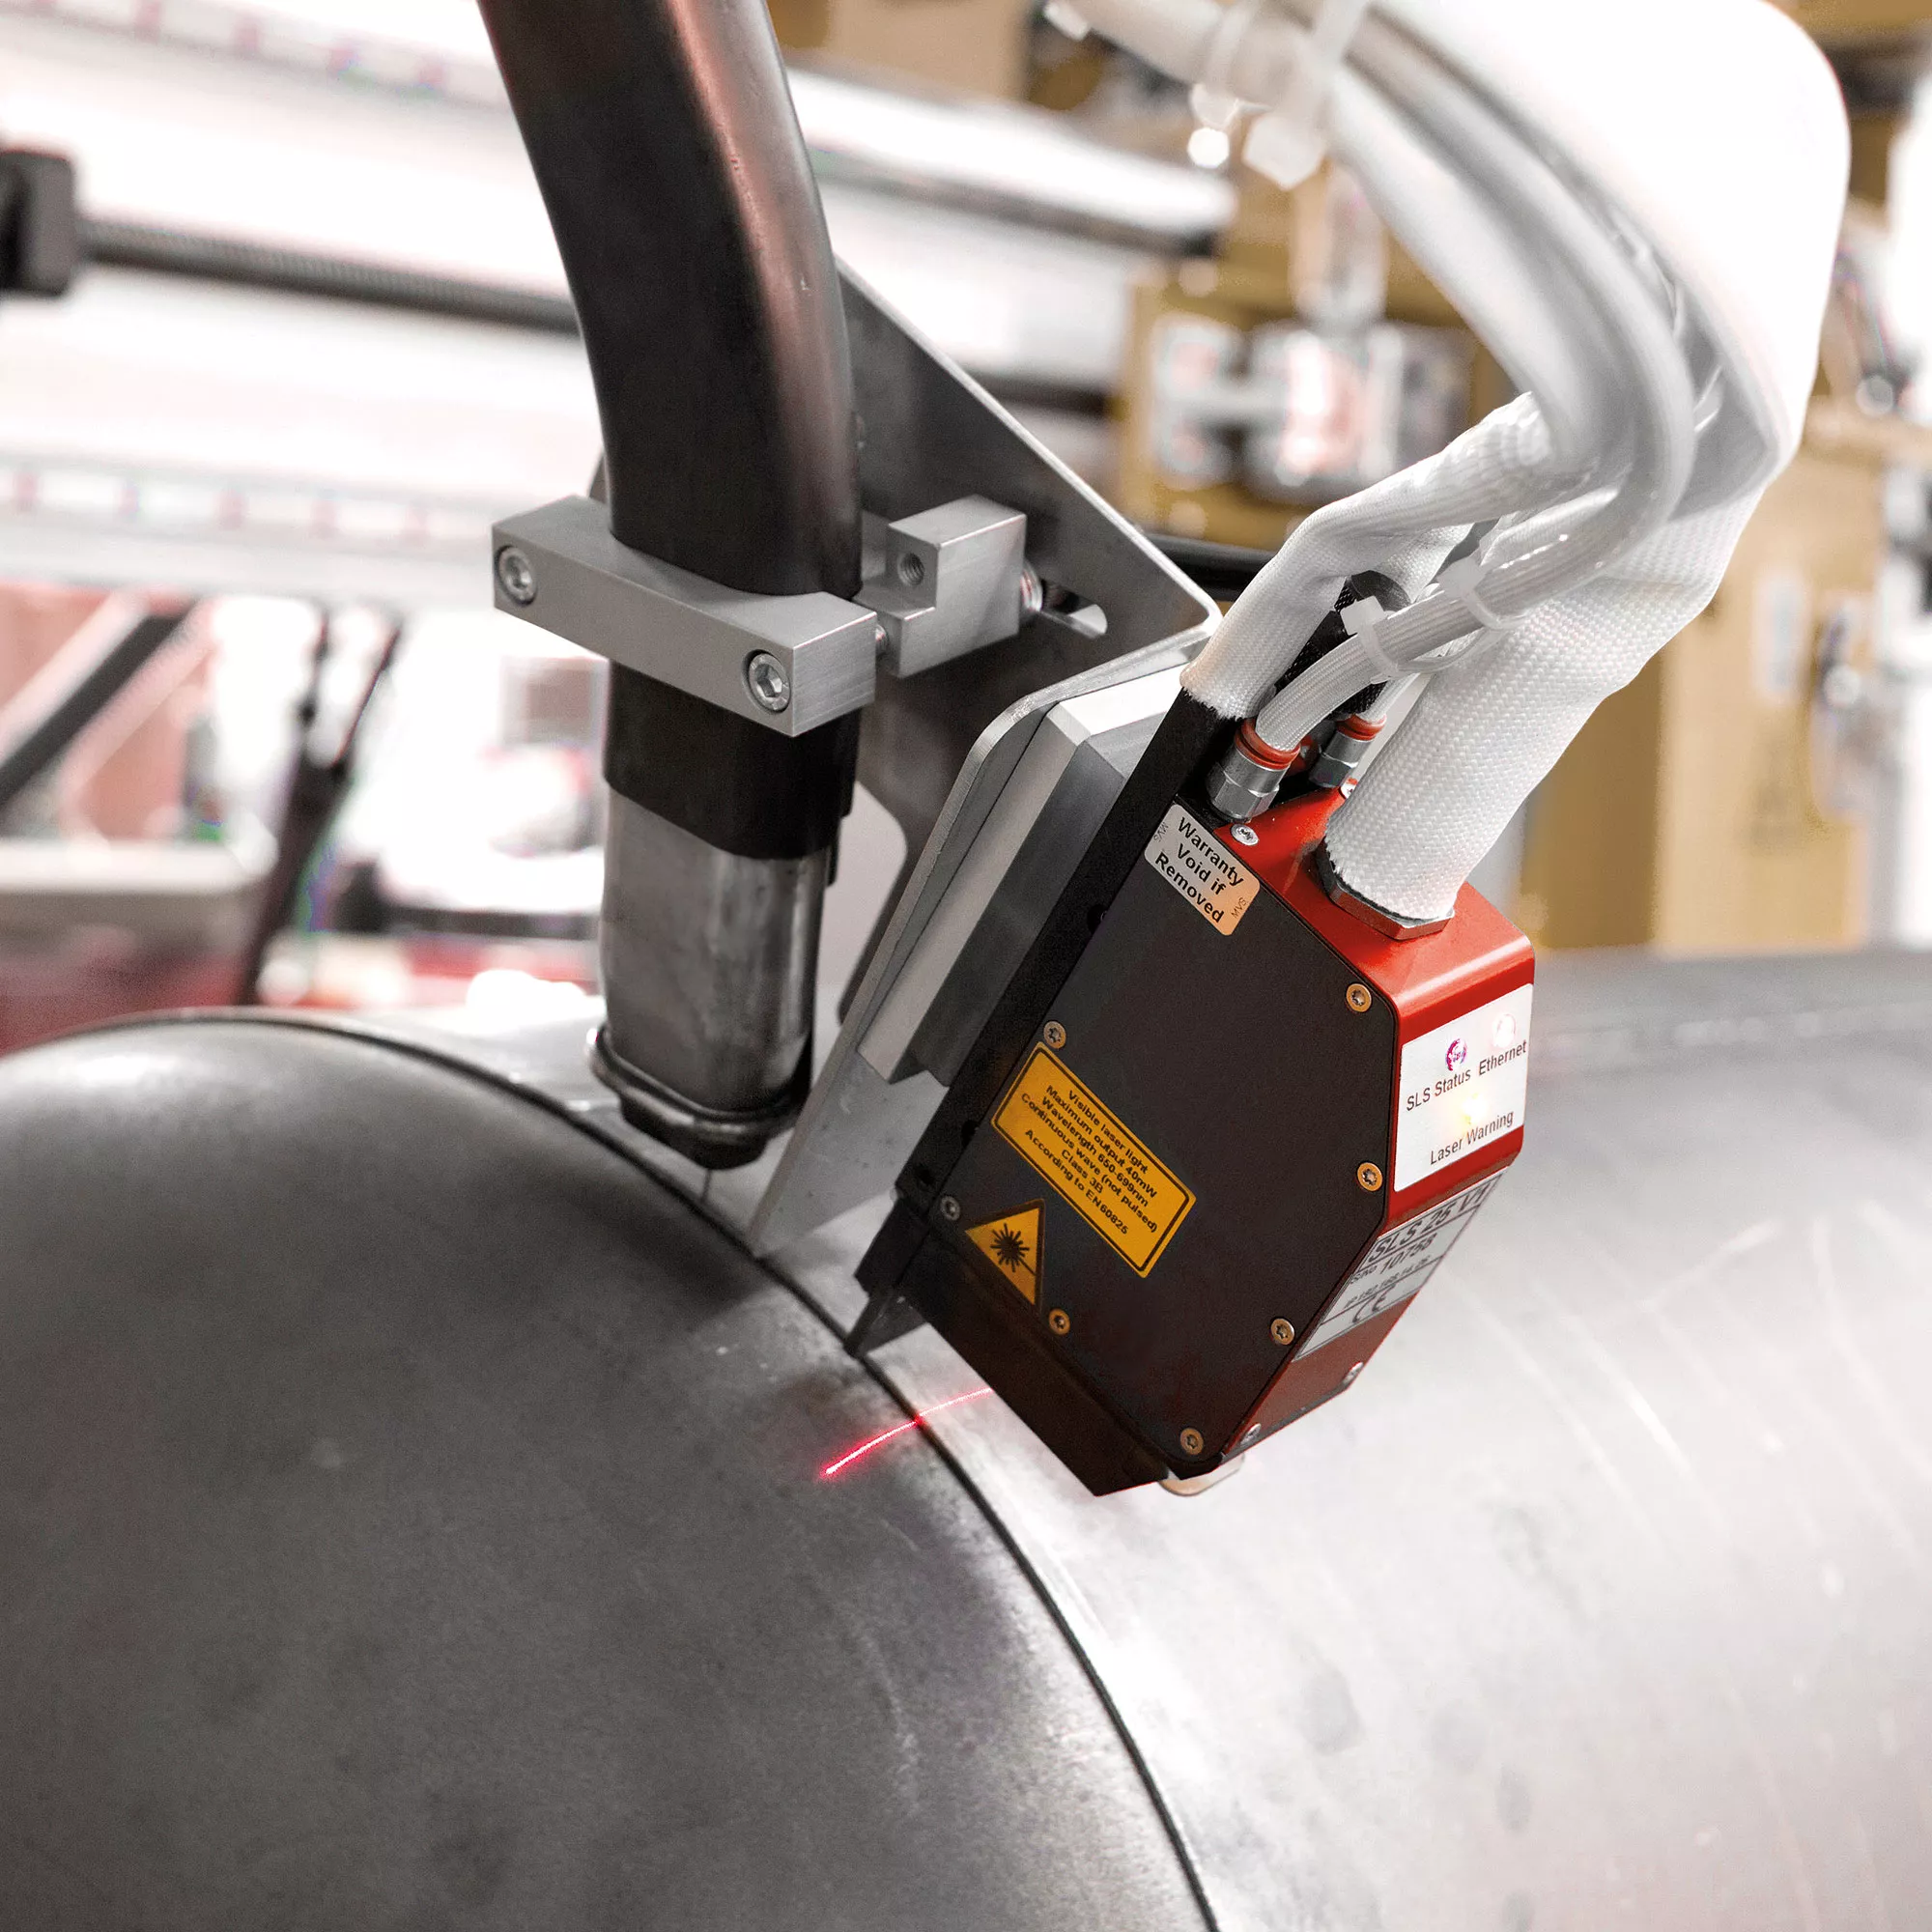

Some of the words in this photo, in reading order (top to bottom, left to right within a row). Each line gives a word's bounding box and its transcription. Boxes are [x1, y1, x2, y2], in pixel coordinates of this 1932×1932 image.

[1177, 843, 1211, 882] Void
[1211, 878, 1226, 895] if
[1178, 817, 1244, 887] Warranty
[1155, 852, 1224, 923] Removed
[1231, 897, 1248, 919] MVS
[1406, 1088, 1431, 1111] SLS
[1435, 1069, 1471, 1096] Status
[1478, 1039, 1527, 1076] Ethernet
[1042, 1096, 1097, 1155] Wavelength
[1046, 1086, 1093, 1135] Maximum
[1094, 1135, 1126, 1168] output
[1126, 1165, 1157, 1199] 40mW
[1068, 1091, 1100, 1125] Visible
[1100, 1123, 1125, 1151] laser
[1125, 1149, 1149, 1175] light
[1431, 1137, 1463, 1165] Laser
[1466, 1111, 1514, 1145] Warning
[1021, 1093, 1075, 1149] Continuous
[1075, 1149, 1100, 1176] wave
[1100, 1174, 1122, 1196] (not
[1121, 1197, 1157, 1233] pulsed)
[1025, 1129, 1073, 1181] According
[1074, 1178, 1085, 1190] to
[1062, 1150, 1089, 1179] Class
[1090, 1178, 1103, 1194] 3B
[1424, 1203, 1456, 1231] 25
